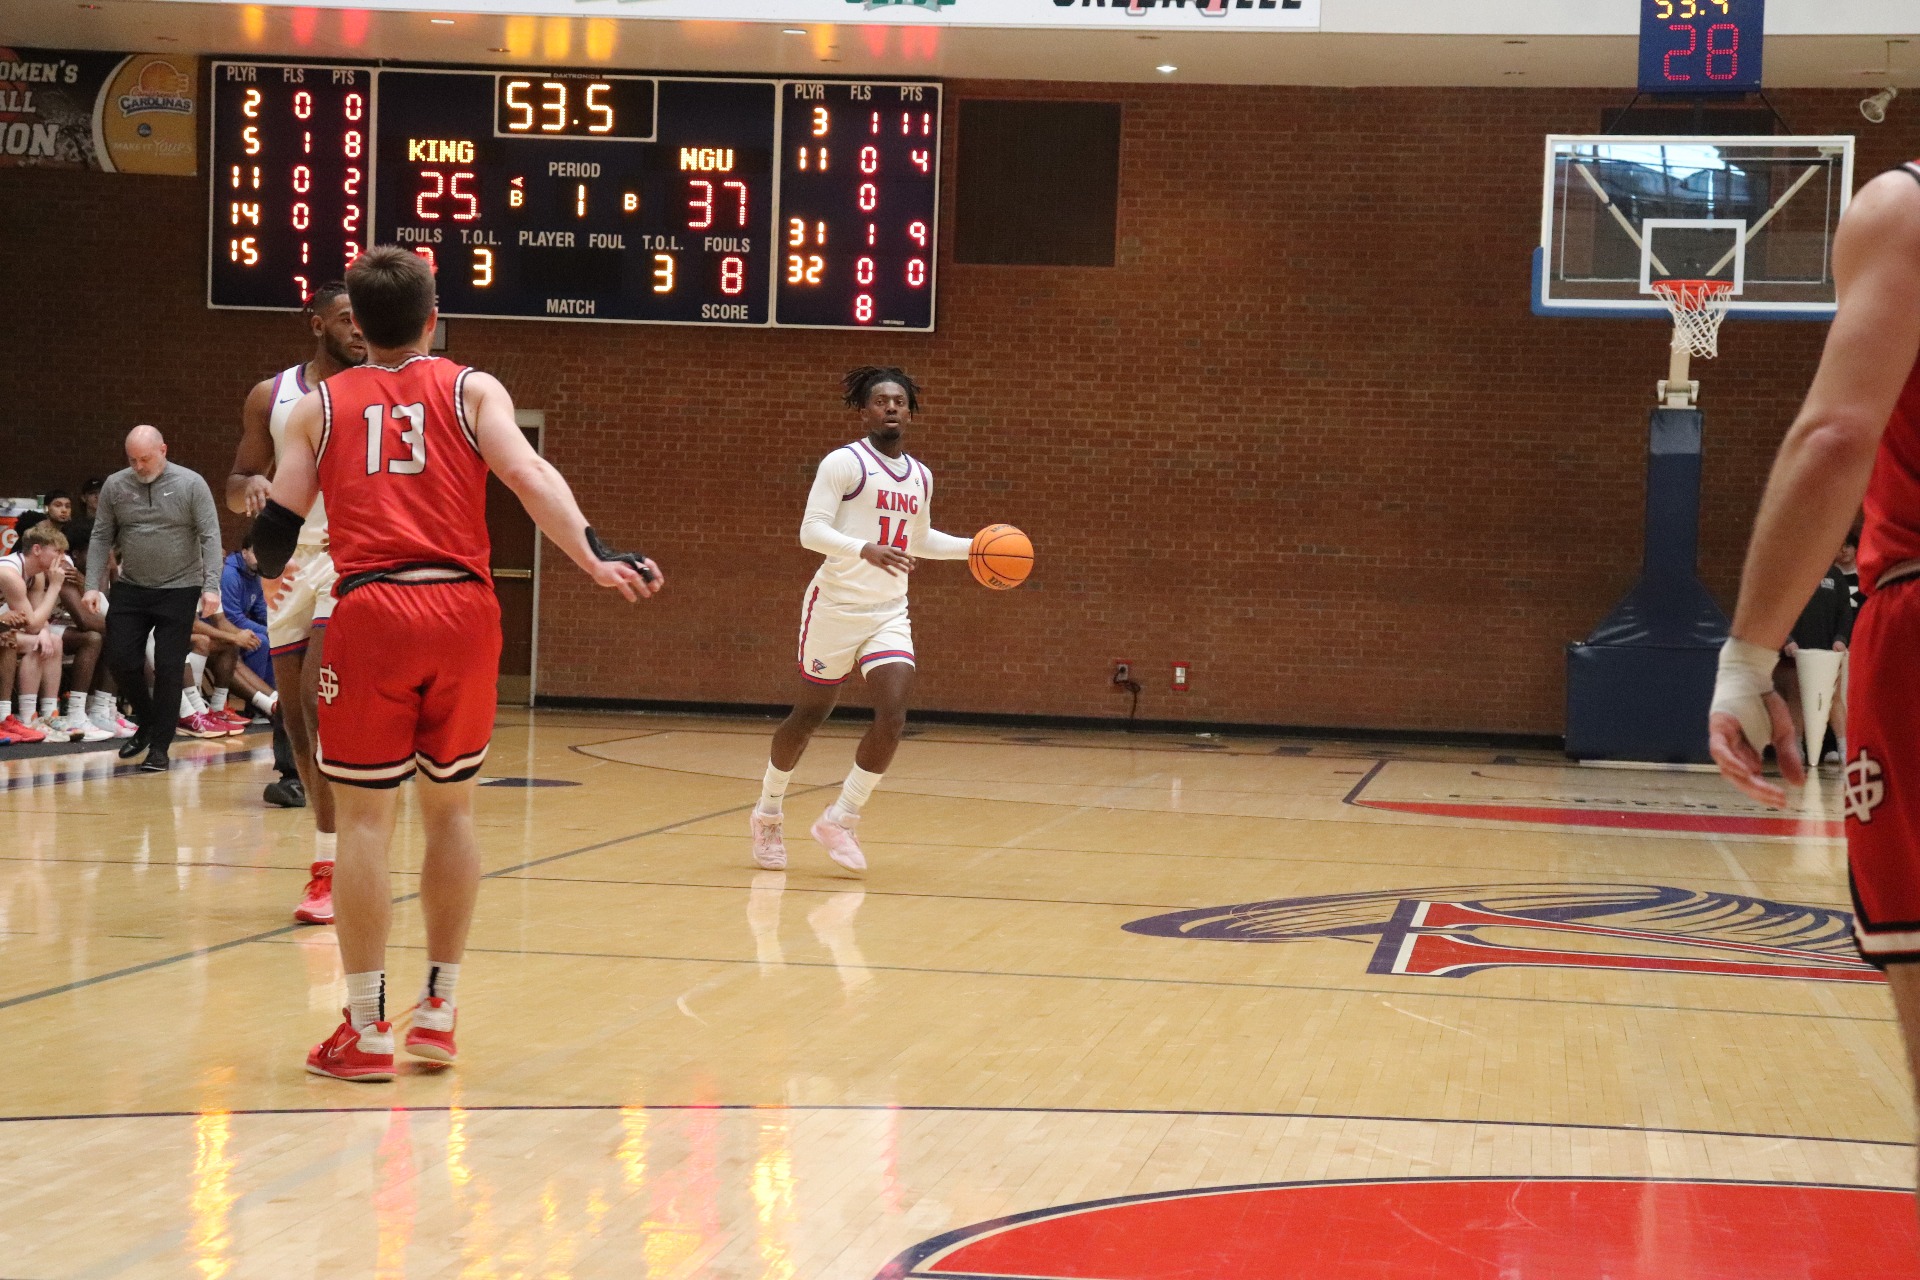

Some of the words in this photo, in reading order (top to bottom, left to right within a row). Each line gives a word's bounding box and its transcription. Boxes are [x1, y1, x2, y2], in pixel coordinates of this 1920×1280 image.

[1664, 24, 1738, 80] 28
[228, 66, 255, 80] PLYR
[284, 67, 305, 82] FLS
[333, 69, 356, 84] PTS
[119, 97, 191, 110] CAROLINAS
[244, 90, 260, 117] 2
[295, 92, 310, 118] 0
[346, 94, 361, 120] 0
[795, 84, 824, 99] PLYR
[851, 85, 871, 100] FLS
[901, 86, 922, 101] PTS
[507, 82, 612, 132] 53.5
[814, 108, 828, 136] 3
[873, 112, 878, 133] 1
[903, 113, 929, 134] 11
[244, 127, 259, 154] 5
[305, 132, 310, 153] 1
[345, 131, 360, 157] 8
[409, 139, 474, 163] KING
[549, 162, 600, 177] PERIOD
[681, 148, 733, 172] NGU
[800, 147, 826, 170] 11
[861, 147, 876, 173] 0
[912, 150, 927, 172] 4
[233, 166, 259, 188] 11
[294, 166, 309, 192] 0
[345, 168, 360, 194] 2
[417, 172, 478, 220] 25
[511, 190, 522, 206] B
[578, 185, 584, 216] 1
[625, 194, 637, 211] B
[689, 180, 746, 228] 37
[860, 184, 875, 210] 0
[233, 203, 258, 225] 14
[293, 203, 308, 229] 0
[344, 205, 359, 231] 2
[397, 228, 442, 242] FOULS
[461, 230, 501, 244] T.O.L.
[519, 231, 574, 247] PLAYER
[590, 234, 625, 248] FOUL
[643, 236, 683, 250] T.O.L.
[705, 237, 750, 252] FOULS
[790, 219, 825, 246] 31
[869, 224, 874, 244] 1
[910, 222, 925, 246] 9
[232, 238, 257, 264] 15
[303, 243, 307, 263] 1
[473, 249, 492, 286] 3
[654, 255, 673, 292] 3
[722, 257, 742, 293] 8
[789, 255, 823, 283] 32
[857, 258, 873, 284] 0
[908, 259, 924, 285] 0
[294, 277, 309, 300] 7
[547, 299, 594, 314] MATCH
[702, 304, 748, 319] SCORE
[856, 295, 872, 321] 8
[363, 402, 426, 476] 13
[876, 489, 919, 515] KING
[877, 516, 908, 552] 14
